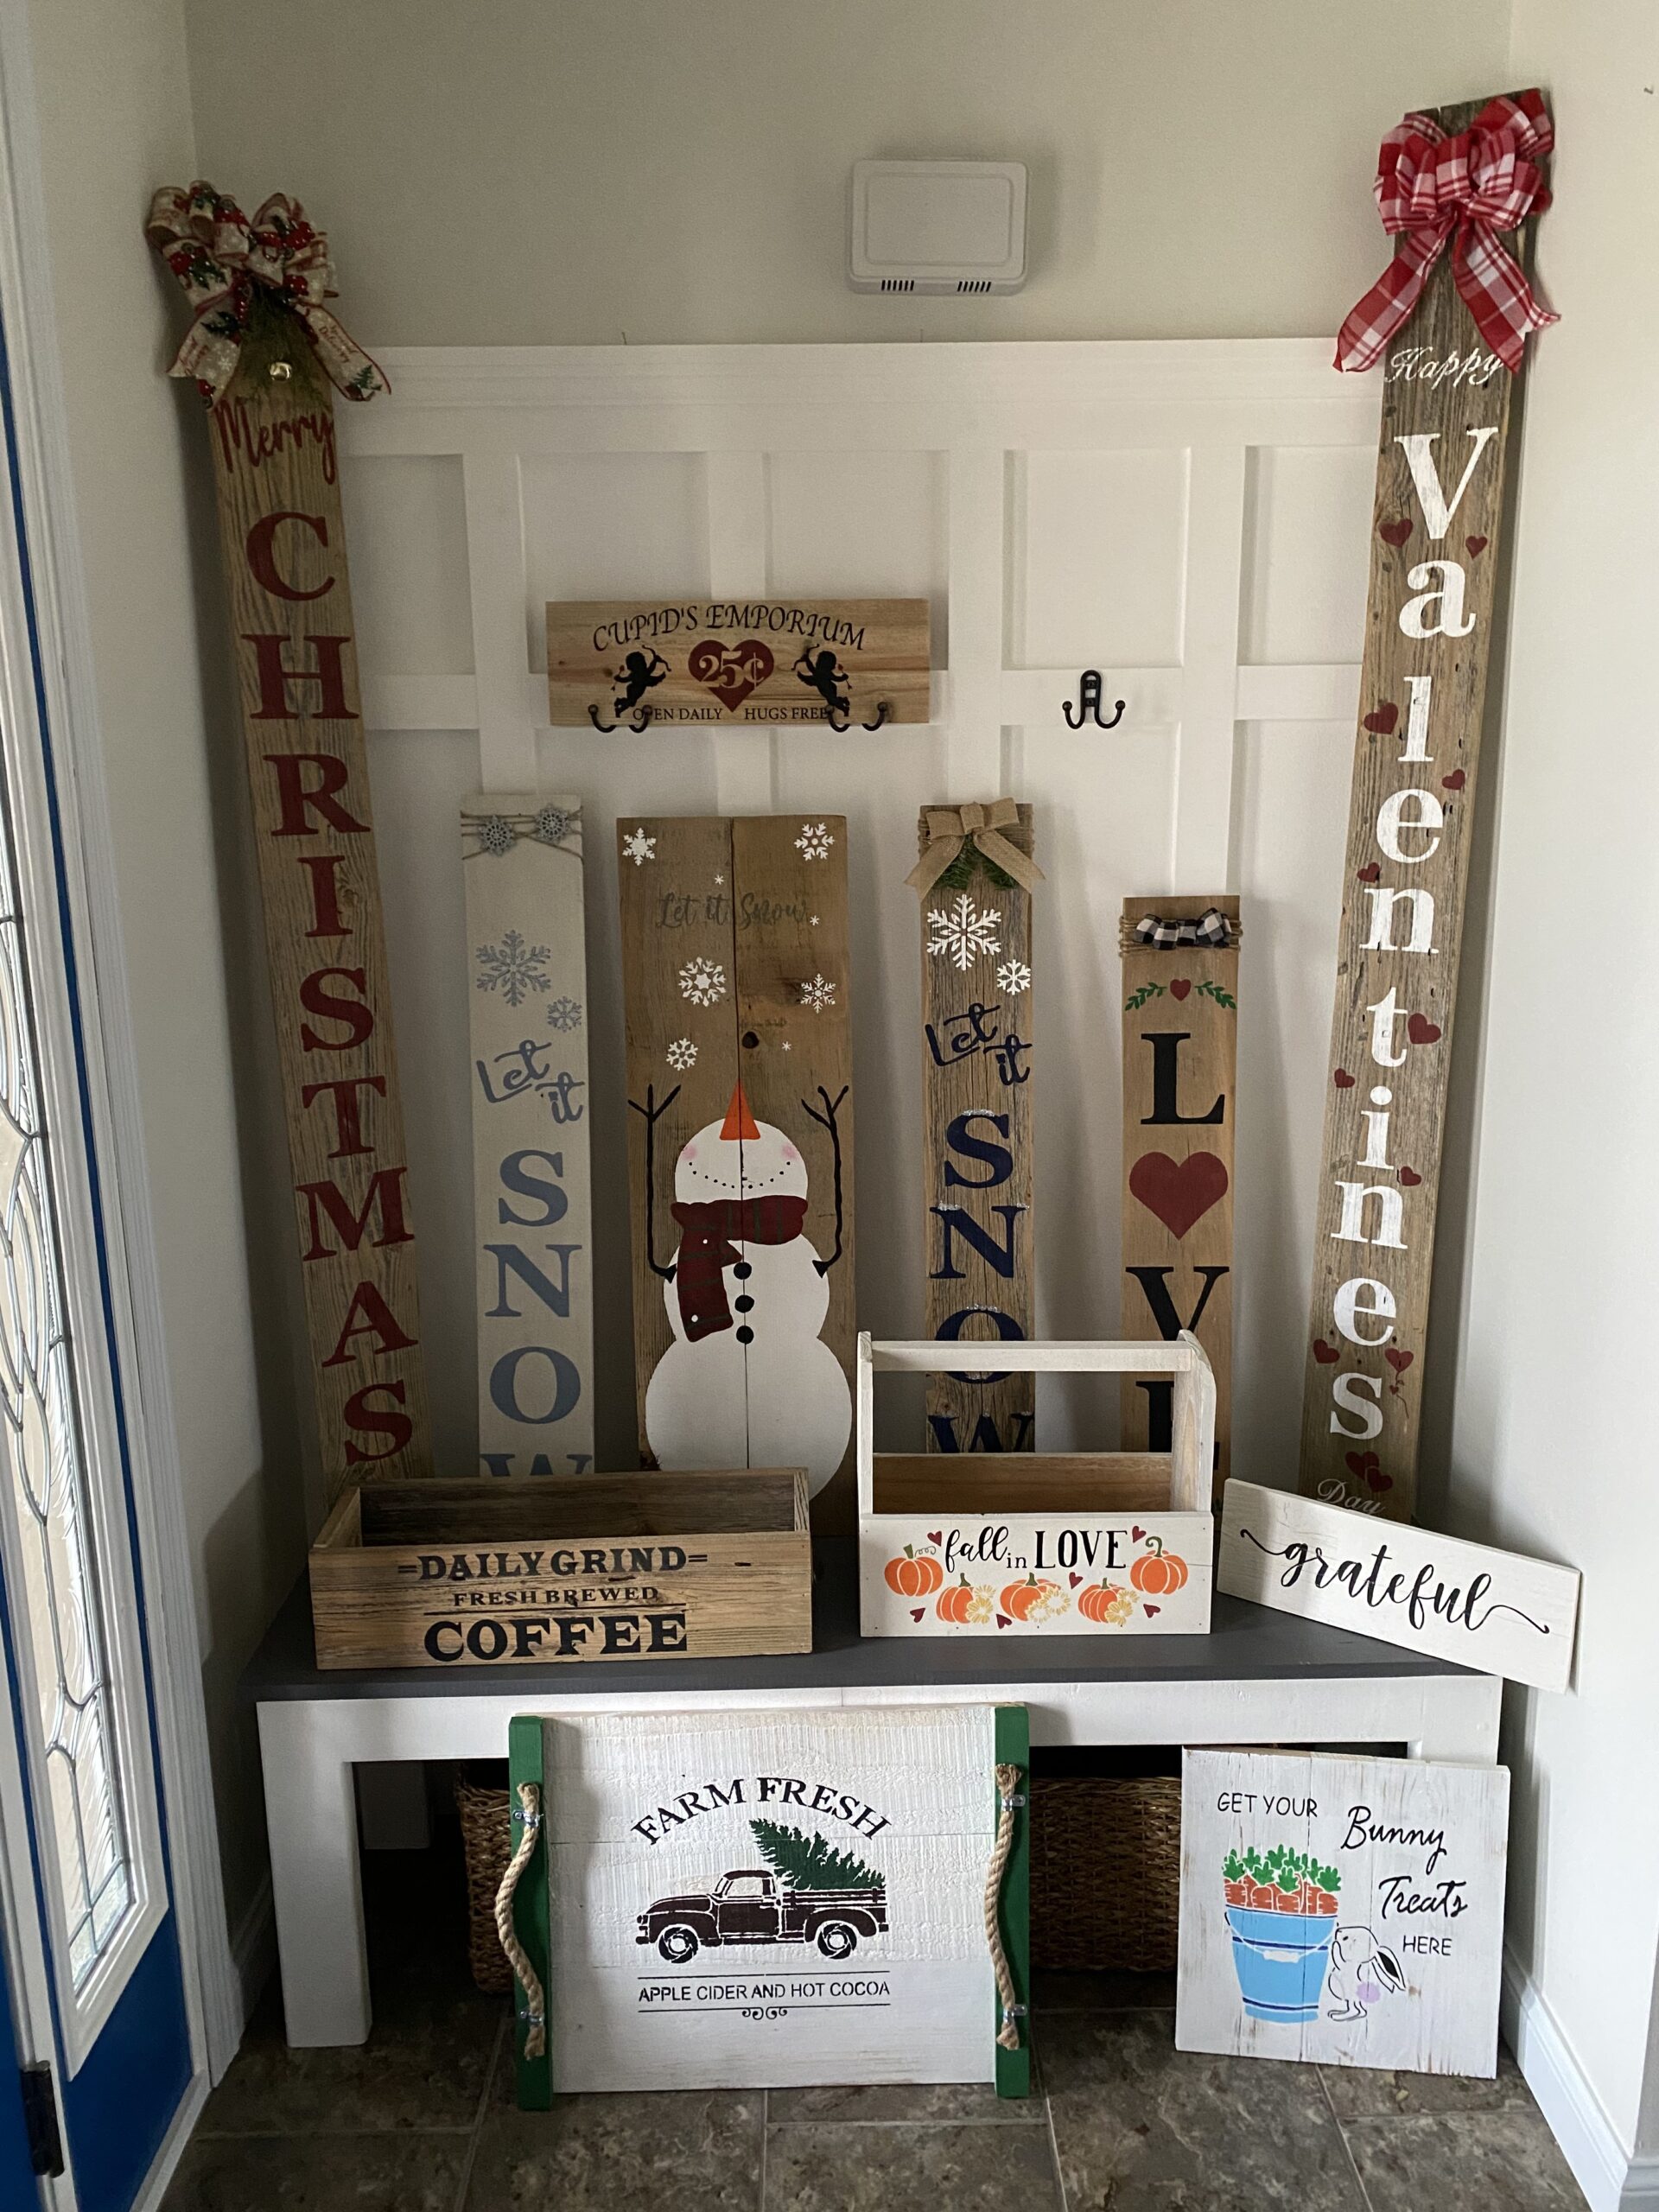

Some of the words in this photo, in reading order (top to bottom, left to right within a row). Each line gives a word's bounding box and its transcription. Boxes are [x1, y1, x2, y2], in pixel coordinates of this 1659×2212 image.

[1384, 346, 1505, 390] Happy
[213, 398, 336, 485] Merry
[593, 605, 697, 652] CUPID'S
[706, 604, 867, 651] EMPORIUM
[632, 707, 677, 721] OEN
[679, 707, 723, 721] DAILY
[744, 707, 788, 721] HUGS
[655, 891, 700, 929] Let
[705, 892, 731, 926] it
[1329, 426, 1499, 1440] Valentines
[240, 511, 420, 1467] CHRISTMAS
[925, 1002, 1001, 1066] Let
[476, 1039, 553, 1103] Let
[982, 1033, 1033, 1086] it
[534, 1071, 586, 1124] it
[416, 1551, 546, 1581] DAILY
[550, 1546, 690, 1576] GRIND
[944, 1526, 1010, 1573] fall
[1006, 1553, 1027, 1569] in
[1034, 1529, 1128, 1569] LOVE
[453, 1590, 537, 1607] FRESH
[545, 1586, 659, 1605] BREWED
[1240, 1529, 1550, 1634] grateful
[423, 1612, 688, 1662] COFFEE
[630, 1778, 747, 1846] FARM
[756, 1777, 893, 1840] FRESH
[1217, 1791, 1258, 1814] GET
[1262, 1796, 1319, 1818] YOUR
[1340, 1805, 1448, 1875] Bunny
[1378, 1875, 1468, 1920] Treats
[1402, 1935, 1452, 1956] HERE
[638, 1986, 691, 2003] APPLE
[696, 1984, 748, 2000] CIDER
[750, 1984, 786, 1999] AND
[790, 1982, 825, 1998] HOT
[829, 1980, 891, 1997] COCOA
